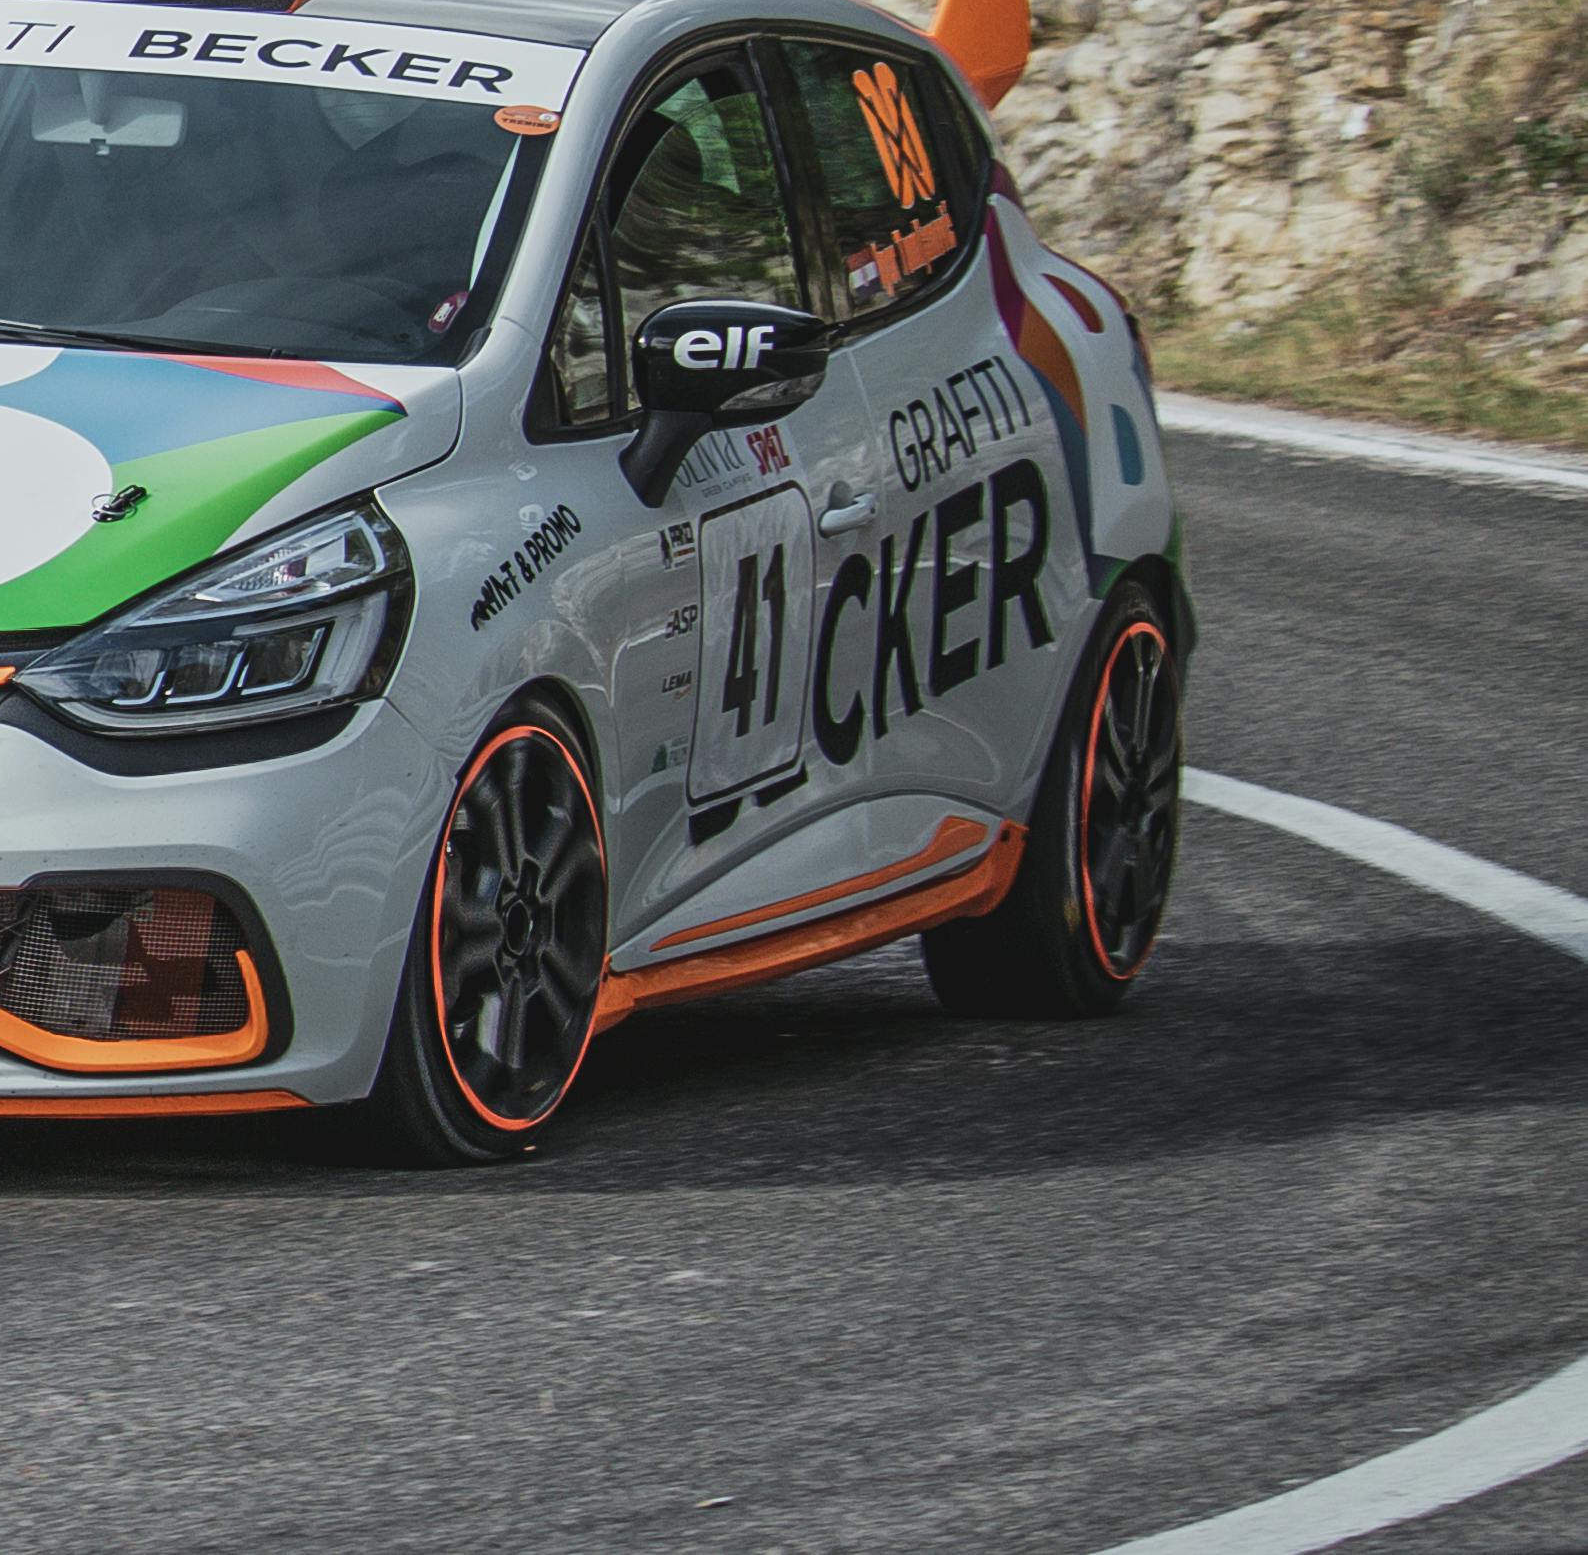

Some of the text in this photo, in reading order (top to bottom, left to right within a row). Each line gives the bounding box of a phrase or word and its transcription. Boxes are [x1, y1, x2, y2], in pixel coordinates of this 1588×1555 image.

[127, 30, 516, 95] BECKER
[672, 325, 774, 371] elf
[889, 355, 1032, 493] GRAFITI
[513, 550, 536, 584] &
[523, 503, 582, 574] PROMO
[722, 542, 786, 738] 41
[661, 670, 693, 694] LEMA
